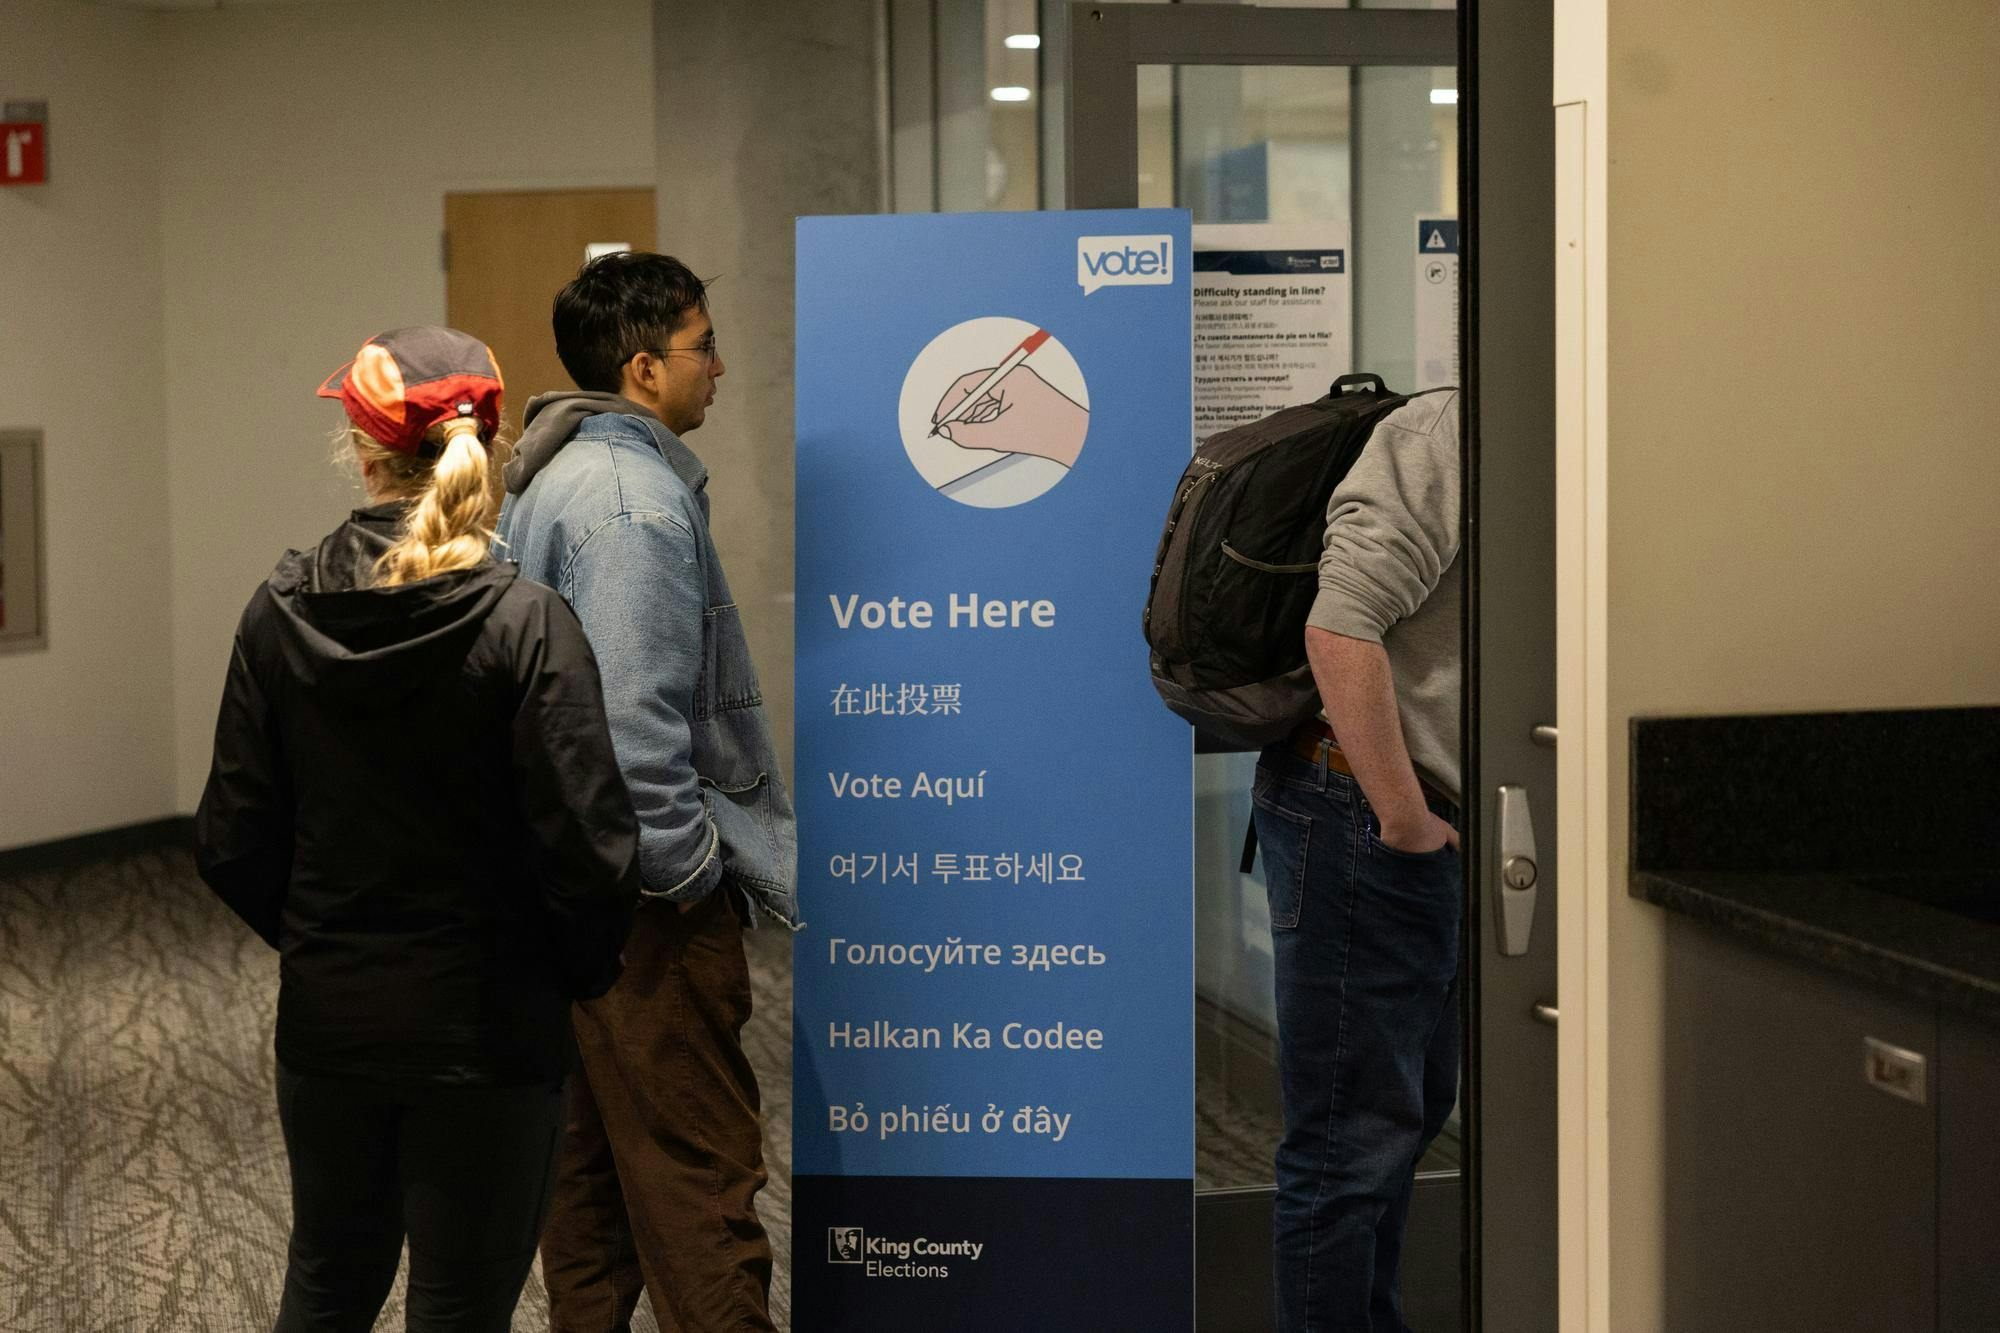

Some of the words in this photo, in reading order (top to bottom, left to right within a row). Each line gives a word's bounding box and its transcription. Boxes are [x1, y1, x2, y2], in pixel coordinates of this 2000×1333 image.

[1083, 241, 1168, 276] vote!
[1193, 287, 1240, 299] Difficulty
[1242, 286, 1287, 298] standing
[1289, 286, 1299, 295] in
[1301, 286, 1326, 295] line?
[1194, 299, 1218, 307] Please
[1250, 298, 1267, 306] staff
[828, 594, 934, 629] Vote
[948, 592, 1057, 629] Here
[829, 683, 963, 717] 在此投票
[828, 772, 902, 799] Vote
[910, 769, 988, 807] Aquí
[829, 851, 919, 885] 여기서
[931, 851, 1086, 885] 투표하세요
[829, 936, 1002, 973] Голосуйте
[1011, 944, 1107, 972] здесь
[829, 1020, 941, 1050] Halkan
[952, 1022, 991, 1050] Ka
[1002, 1021, 1104, 1050] Codee
[829, 1102, 869, 1133] Bỏ
[880, 1103, 970, 1141] phiếu
[981, 1102, 1005, 1133] ở
[1011, 1105, 1072, 1142] đây
[866, 1237, 911, 1260] King
[913, 1237, 983, 1262] County
[866, 1260, 949, 1279] Elections
